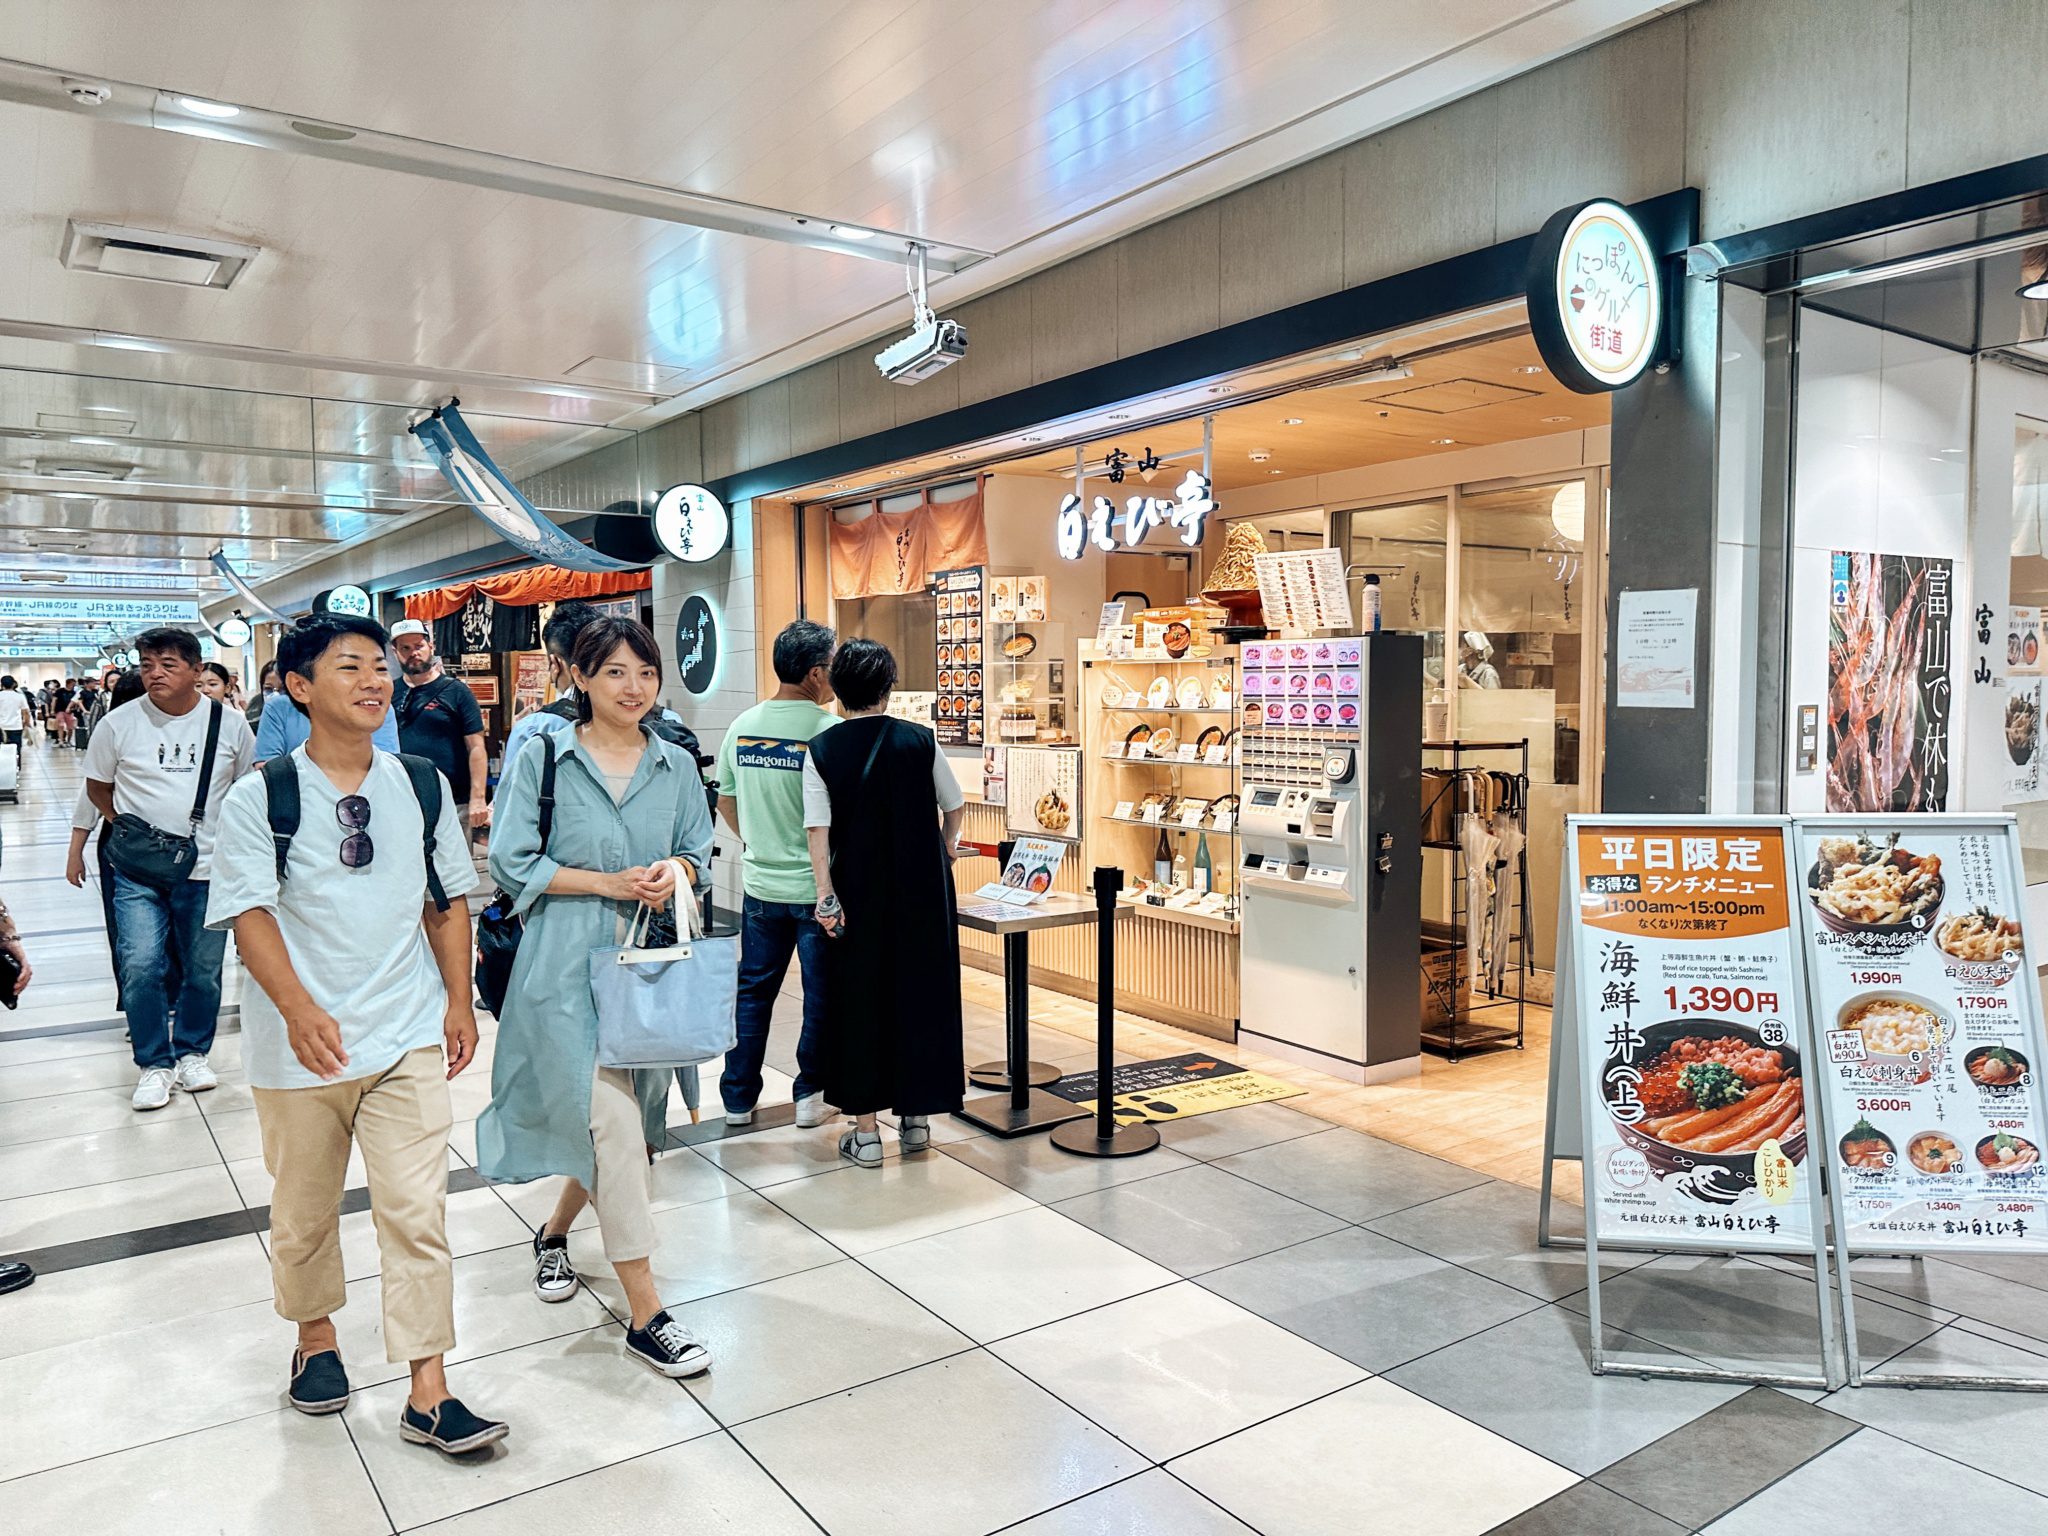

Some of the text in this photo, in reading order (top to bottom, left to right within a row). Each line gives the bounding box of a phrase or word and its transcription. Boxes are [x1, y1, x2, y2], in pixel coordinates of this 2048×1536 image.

[1577, 241, 1635, 284] にっぽん
[1590, 324, 1622, 354] 街道
[1105, 447, 1161, 483] 富山
[696, 493, 705, 512] 富山
[1058, 470, 1219, 560] 白えび亭
[680, 497, 694, 555] 白えび亭
[1974, 603, 1994, 684] 富山
[739, 754, 800, 768] patagonia
[1601, 837, 1763, 872] 平日限定
[1591, 876, 1774, 895] お得な ランチメニュー
[1638, 918, 1728, 931] なくなり次第終了
[1914, 917, 1922, 927] 1
[1815, 931, 1928, 947] 富山スペシャル天丼
[1662, 964, 1764, 974] Bowl of rice topped with Sashimi
[1945, 965, 2011, 978] 白えび天丼
[1662, 972, 1677, 980] (Red
[1696, 972, 1711, 981] crab,
[1712, 973, 1729, 981] Tuna,
[1730, 973, 1754, 981] Salmon
[1850, 972, 1902, 984] 1,990円
[1664, 986, 1779, 1013] 1,390円
[1956, 997, 2008, 1009] 1,790円
[1763, 1029, 1784, 1042] 38
[1834, 1040, 1859, 1050] 白えび
[1911, 1051, 1920, 1062] 6
[1840, 1065, 1921, 1081] 白えび刺身丼
[2023, 1074, 2031, 1085] 8
[1857, 1099, 1911, 1112] 3,600円
[1988, 1120, 2024, 1129] 3,480円
[1886, 1154, 1893, 1163] 9
[1762, 1148, 1774, 1198] こしひかり
[1776, 1158, 1789, 1189] 富山米
[1950, 1164, 1963, 1174] 10
[2033, 1165, 2046, 1175] 12
[1622, 1198, 1642, 1206] shrimp
[1926, 1202, 1961, 1211] 1,340円
[1997, 1203, 2034, 1213] 3,480円
[1620, 1213, 1781, 1235] 元祖白えび天丼 富山白えび亭
[1943, 1218, 2028, 1238] 富山白えび亭
